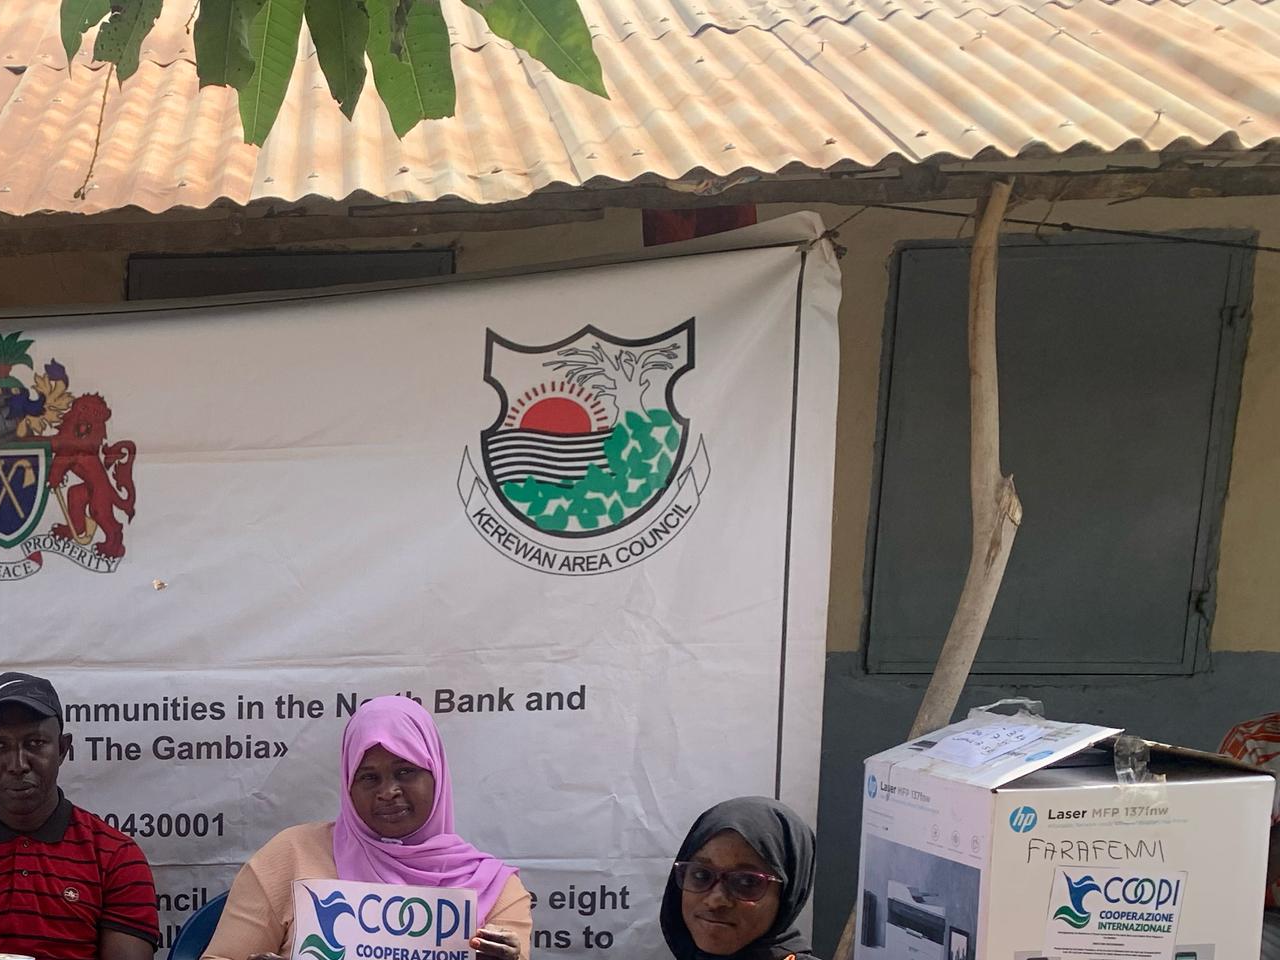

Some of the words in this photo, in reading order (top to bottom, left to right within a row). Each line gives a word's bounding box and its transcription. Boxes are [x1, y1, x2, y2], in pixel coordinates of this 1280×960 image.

[472, 507, 558, 569] KEREWAN
[558, 552, 613, 572] AREA
[615, 502, 694, 564] COUNCIL
[24, 535, 117, 573] PROSPERITY
[65, 696, 226, 723] mmunities
[237, 695, 264, 720] in
[275, 694, 324, 719] the
[434, 687, 515, 714] Bank
[525, 685, 586, 711] and
[85, 736, 142, 761] The
[152, 735, 289, 762] Gambia»
[1048, 809, 1087, 820] Laser
[1092, 807, 1120, 818] MFP
[1124, 806, 1169, 817] 137fnw
[1027, 838, 1165, 863] FARAFENNI
[156, 888, 207, 911] ncil
[548, 885, 630, 916] eight
[1104, 876, 1180, 910] COOPI
[358, 893, 470, 946] COOPI
[1098, 921, 1172, 933] INTERNAZIONALE
[1100, 910, 1174, 923] COOPERAZIONE
[530, 929, 571, 949] ns
[583, 925, 614, 949] to
